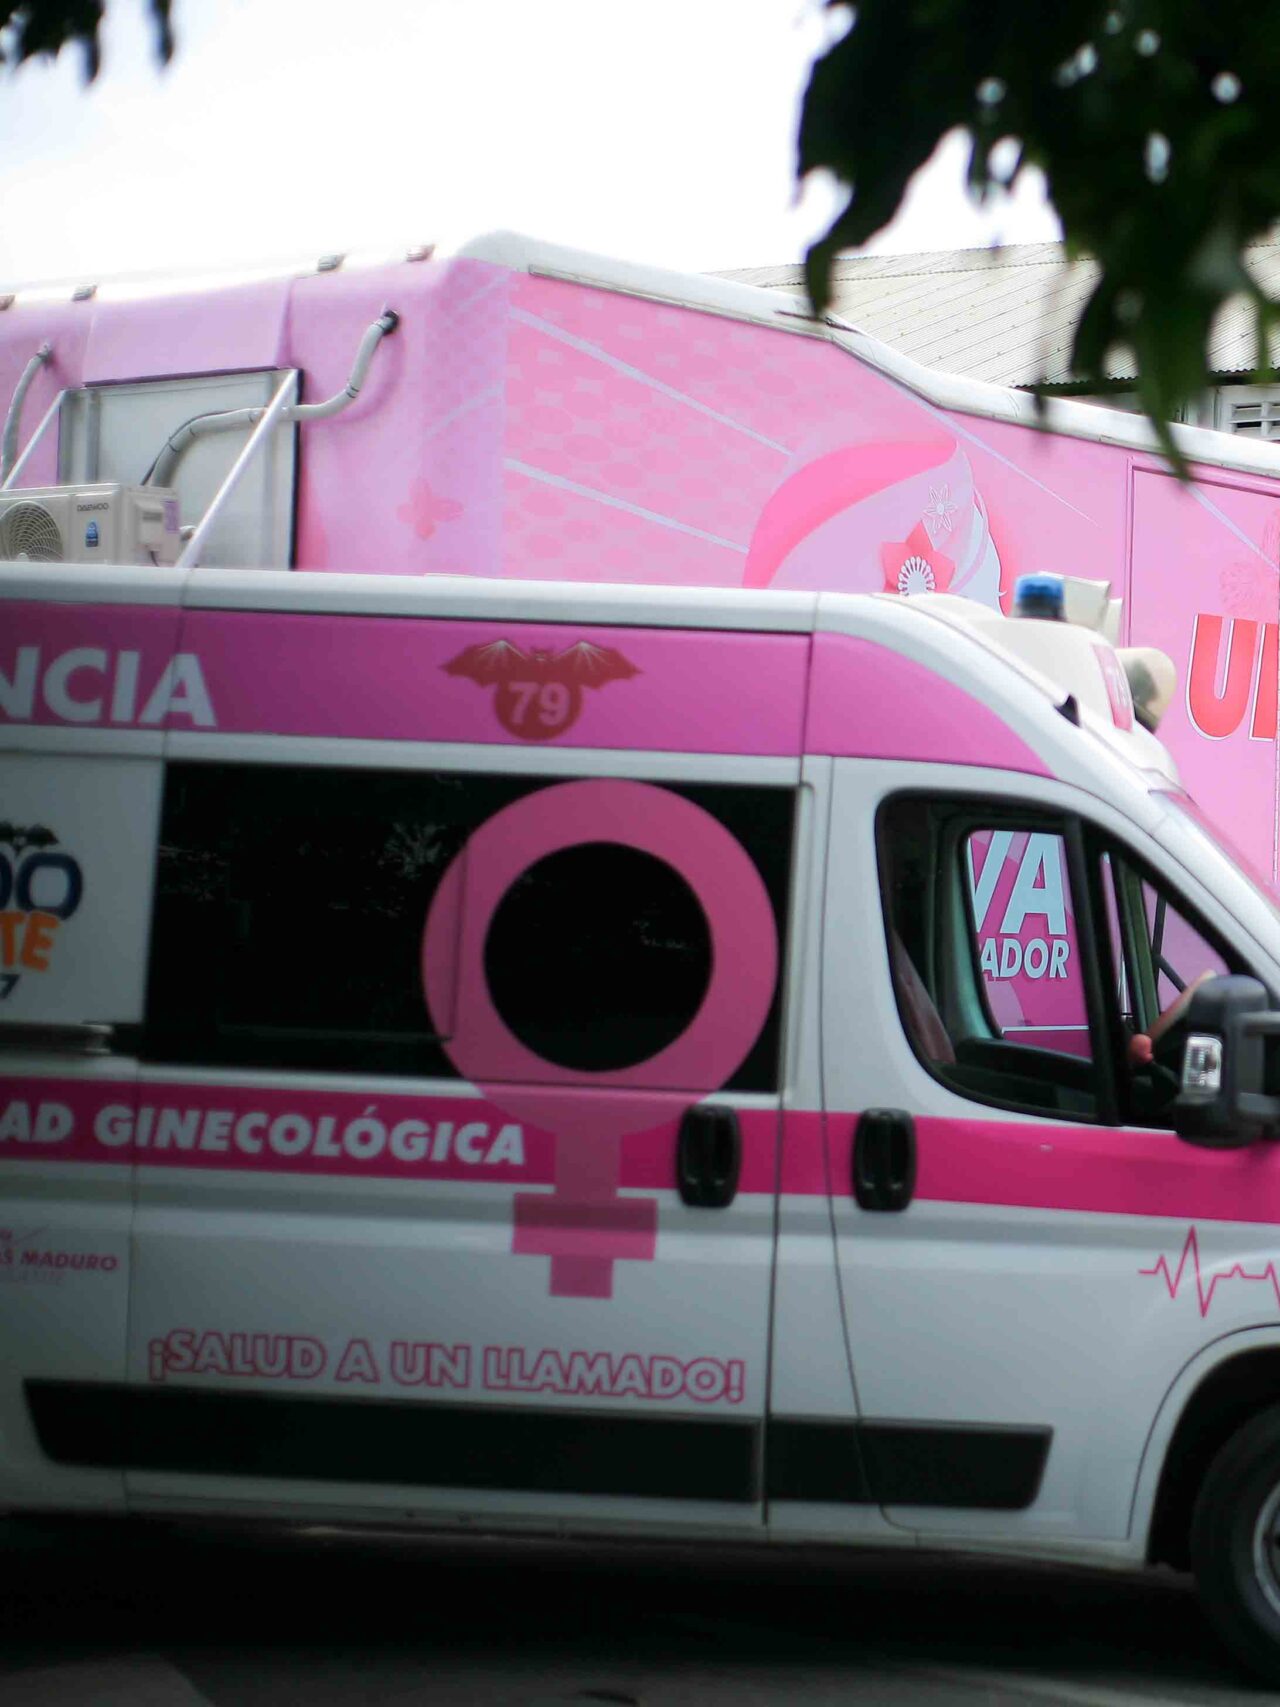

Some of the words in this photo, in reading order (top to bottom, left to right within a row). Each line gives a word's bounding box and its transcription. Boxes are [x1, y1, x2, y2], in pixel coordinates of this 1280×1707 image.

[509, 681, 572, 725] 79
[94, 1106, 525, 1165] GINECOLÓGICA
[22, 1250, 118, 1271] MADURO
[148, 1329, 325, 1382] ¡SALUD
[335, 1339, 380, 1384] A
[391, 1341, 472, 1388] UN
[482, 1346, 745, 1403] LLAMADO!
